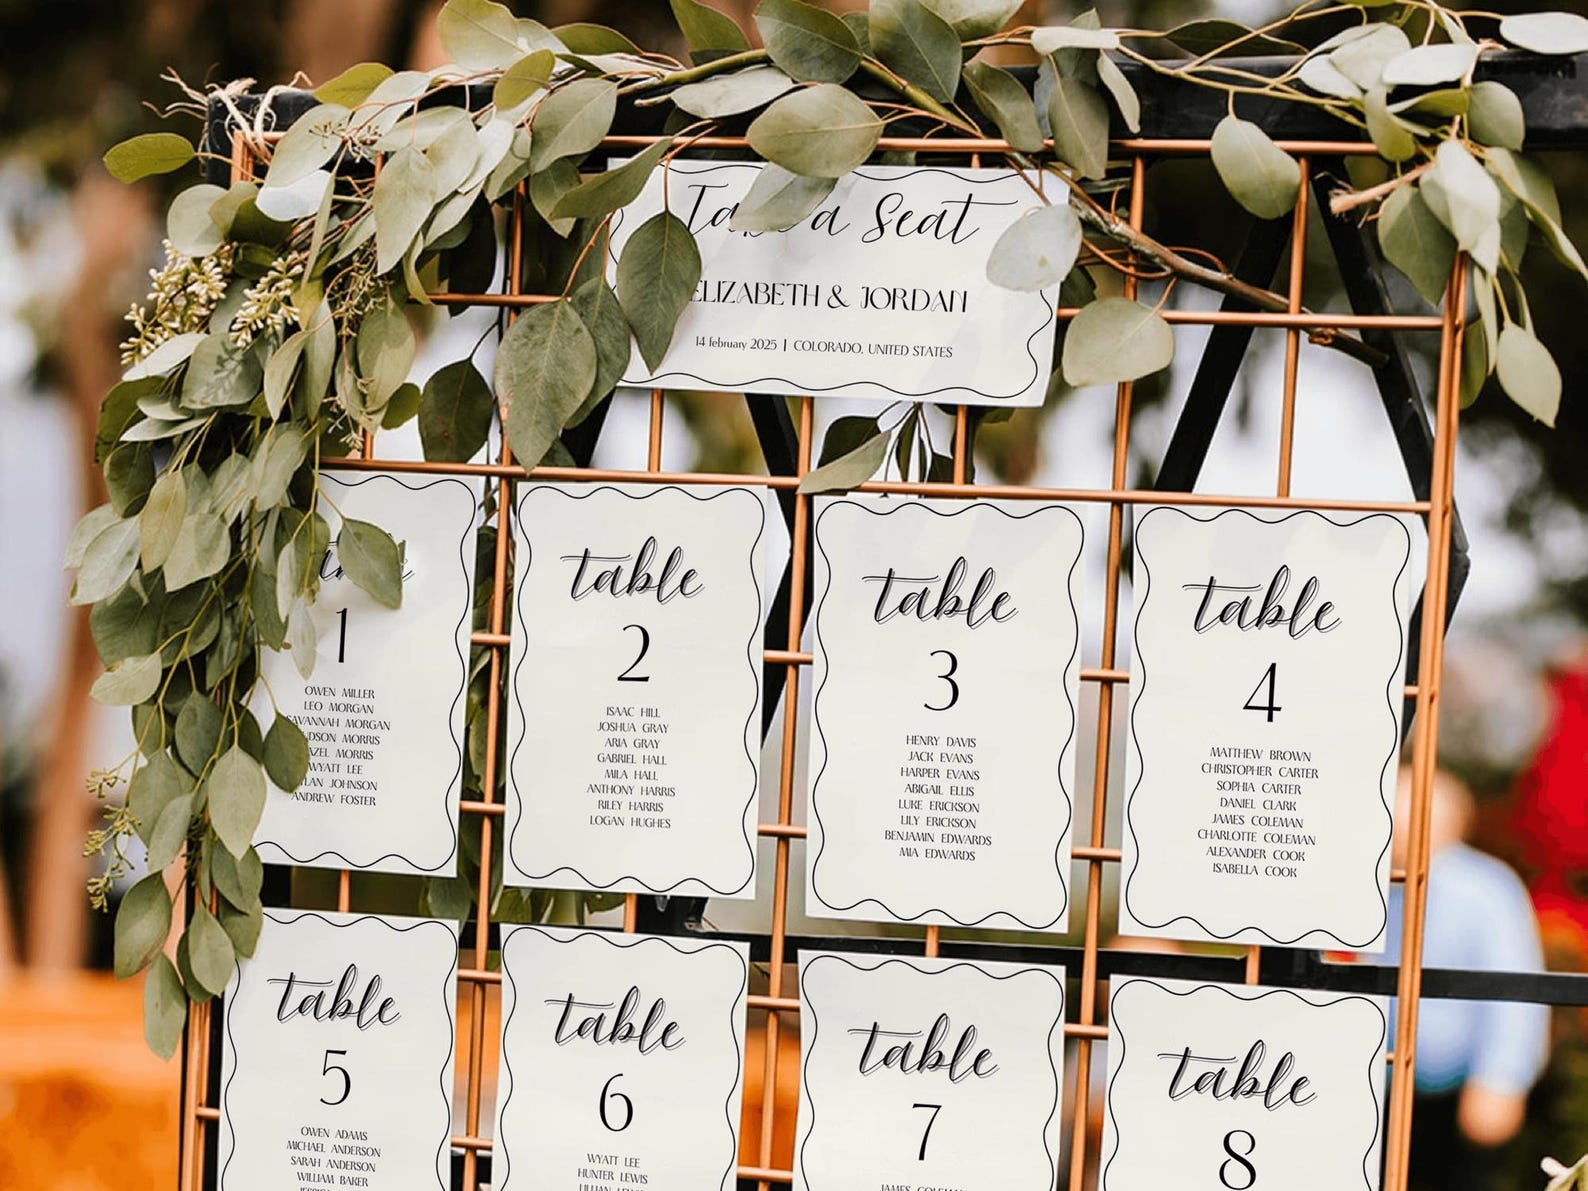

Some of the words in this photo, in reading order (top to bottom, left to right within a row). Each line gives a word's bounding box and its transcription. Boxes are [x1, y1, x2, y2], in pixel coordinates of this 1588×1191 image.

[687, 183, 801, 238] Ta
[811, 205, 850, 236] a
[861, 192, 1018, 244] Seat
[827, 284, 850, 309] &
[860, 286, 968, 312] JORDAN
[695, 335, 705, 346] 14
[708, 336, 747, 351] february
[750, 338, 777, 350] 2025
[868, 343, 909, 356] UNITED
[912, 345, 953, 358] STATES
[560, 536, 703, 605] table
[862, 556, 1018, 629] table
[1182, 564, 1342, 640] table
[336, 607, 348, 663] 1
[617, 624, 650, 682] 2
[924, 650, 959, 711] 3
[305, 686, 336, 697] OWEN
[342, 688, 375, 699] MILLER
[1243, 663, 1282, 722] 4
[304, 701, 323, 711] LEO
[329, 703, 375, 714] MORGAN
[606, 706, 634, 717] ISAAC
[640, 707, 660, 718] HILL
[605, 737, 628, 748] ARIA
[633, 738, 660, 749] GRAY
[906, 735, 940, 746] HENRY
[946, 736, 976, 748] DAVIS
[1210, 747, 1263, 759] MATTHEW
[1269, 750, 1311, 762] BROWN
[308, 762, 341, 773] WYATT
[347, 765, 363, 775] LEE
[587, 784, 633, 795] ANTHONY
[641, 786, 676, 797] HARRIS
[904, 783, 943, 795] ABIGAIL
[950, 785, 975, 797] ELLIS
[1216, 780, 1255, 792] SOPHIA
[1261, 783, 1301, 795] CARTER
[291, 792, 335, 803] ANDREW
[340, 795, 376, 806] FOSTER
[590, 815, 624, 826] LOGAN
[631, 817, 671, 829] HUGHES
[1197, 829, 1257, 842] CHARLOTTE
[1263, 833, 1316, 846] COLEMAN
[899, 847, 919, 858] MIA
[925, 848, 976, 861] EDWARDS
[1213, 863, 1259, 875] ISABELLA
[1264, 866, 1297, 878] COOK
[267, 963, 401, 1031] table
[544, 986, 686, 1055] table
[847, 1013, 1000, 1084] table
[320, 1049, 351, 1105] 5
[1157, 1039, 1317, 1111] table
[600, 1073, 633, 1132] 6
[301, 1126, 330, 1138] OWEN
[335, 1129, 368, 1141] ADAMS
[912, 1103, 942, 1161] 7
[587, 1153, 618, 1165] WYATT
[624, 1157, 640, 1168] LEE
[1219, 1130, 1256, 1190] 8
[297, 1171, 335, 1184] WILLIAM
[340, 1175, 368, 1187] BAKER
